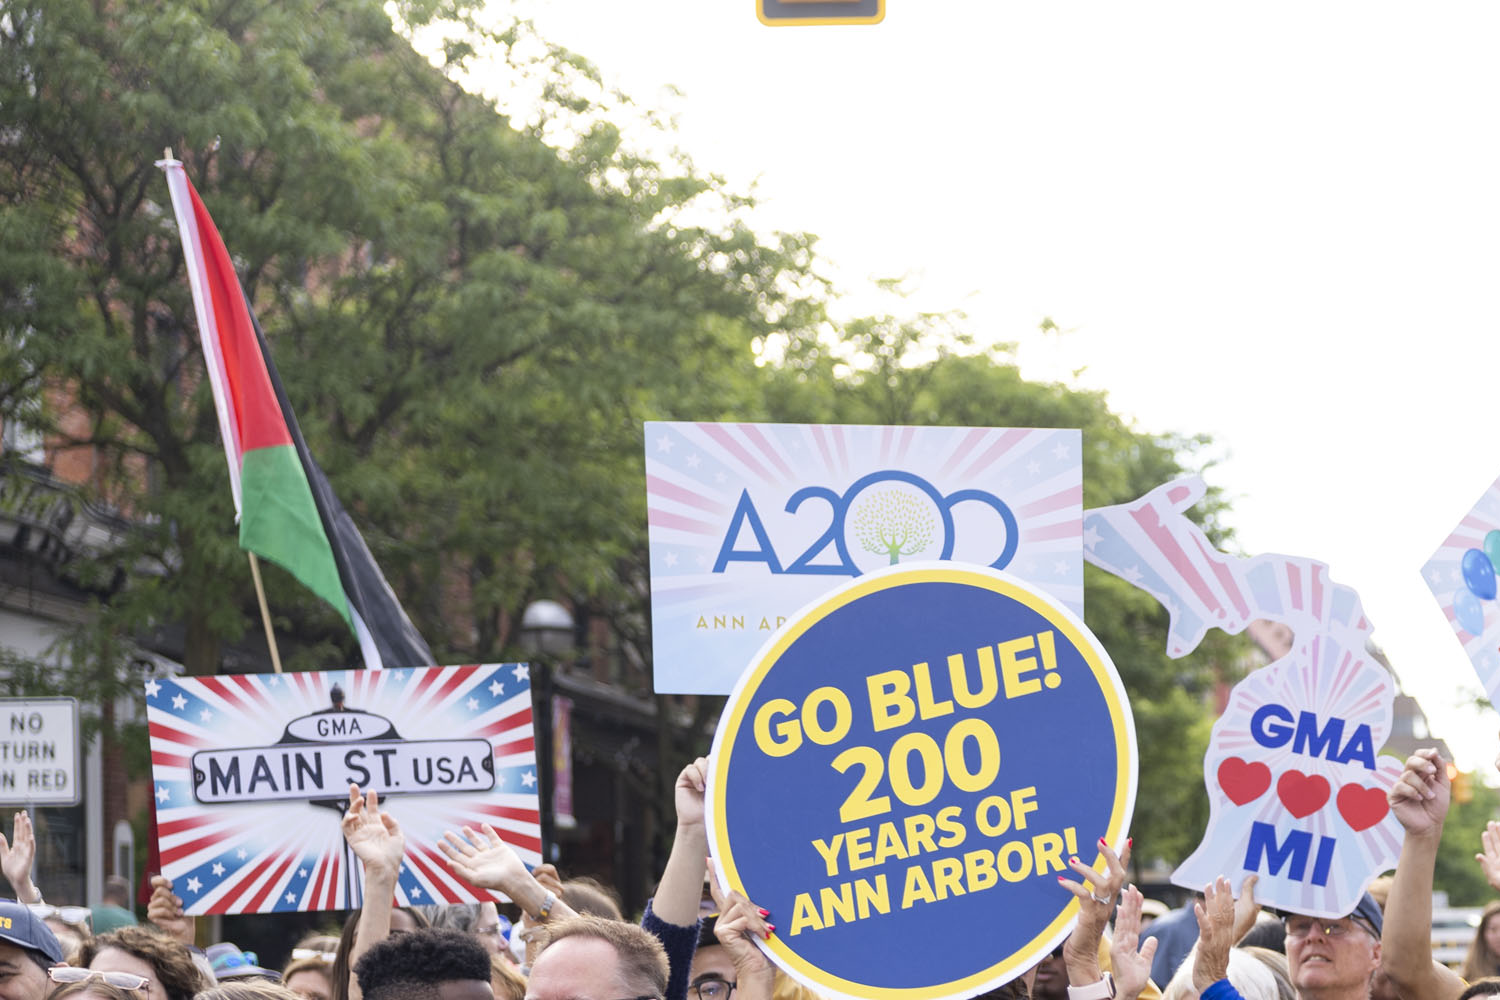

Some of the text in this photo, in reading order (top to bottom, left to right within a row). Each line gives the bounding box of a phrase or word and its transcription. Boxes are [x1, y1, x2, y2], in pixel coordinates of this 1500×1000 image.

[713, 470, 1018, 578] A200
[696, 615, 744, 629] ANN
[10, 712, 43, 734] NO
[753, 630, 1063, 757] GO BLUE!
[0, 740, 55, 763] TURN
[317, 717, 363, 737] GMA
[1250, 703, 1376, 770] GMA
[0, 769, 68, 791] N RED
[208, 747, 479, 796] MAIN ST. USA
[831, 718, 1001, 823] 200
[812, 786, 1038, 876] YEARS OF
[1243, 821, 1337, 887] MI
[789, 827, 1080, 936] ANN ARBOR!
